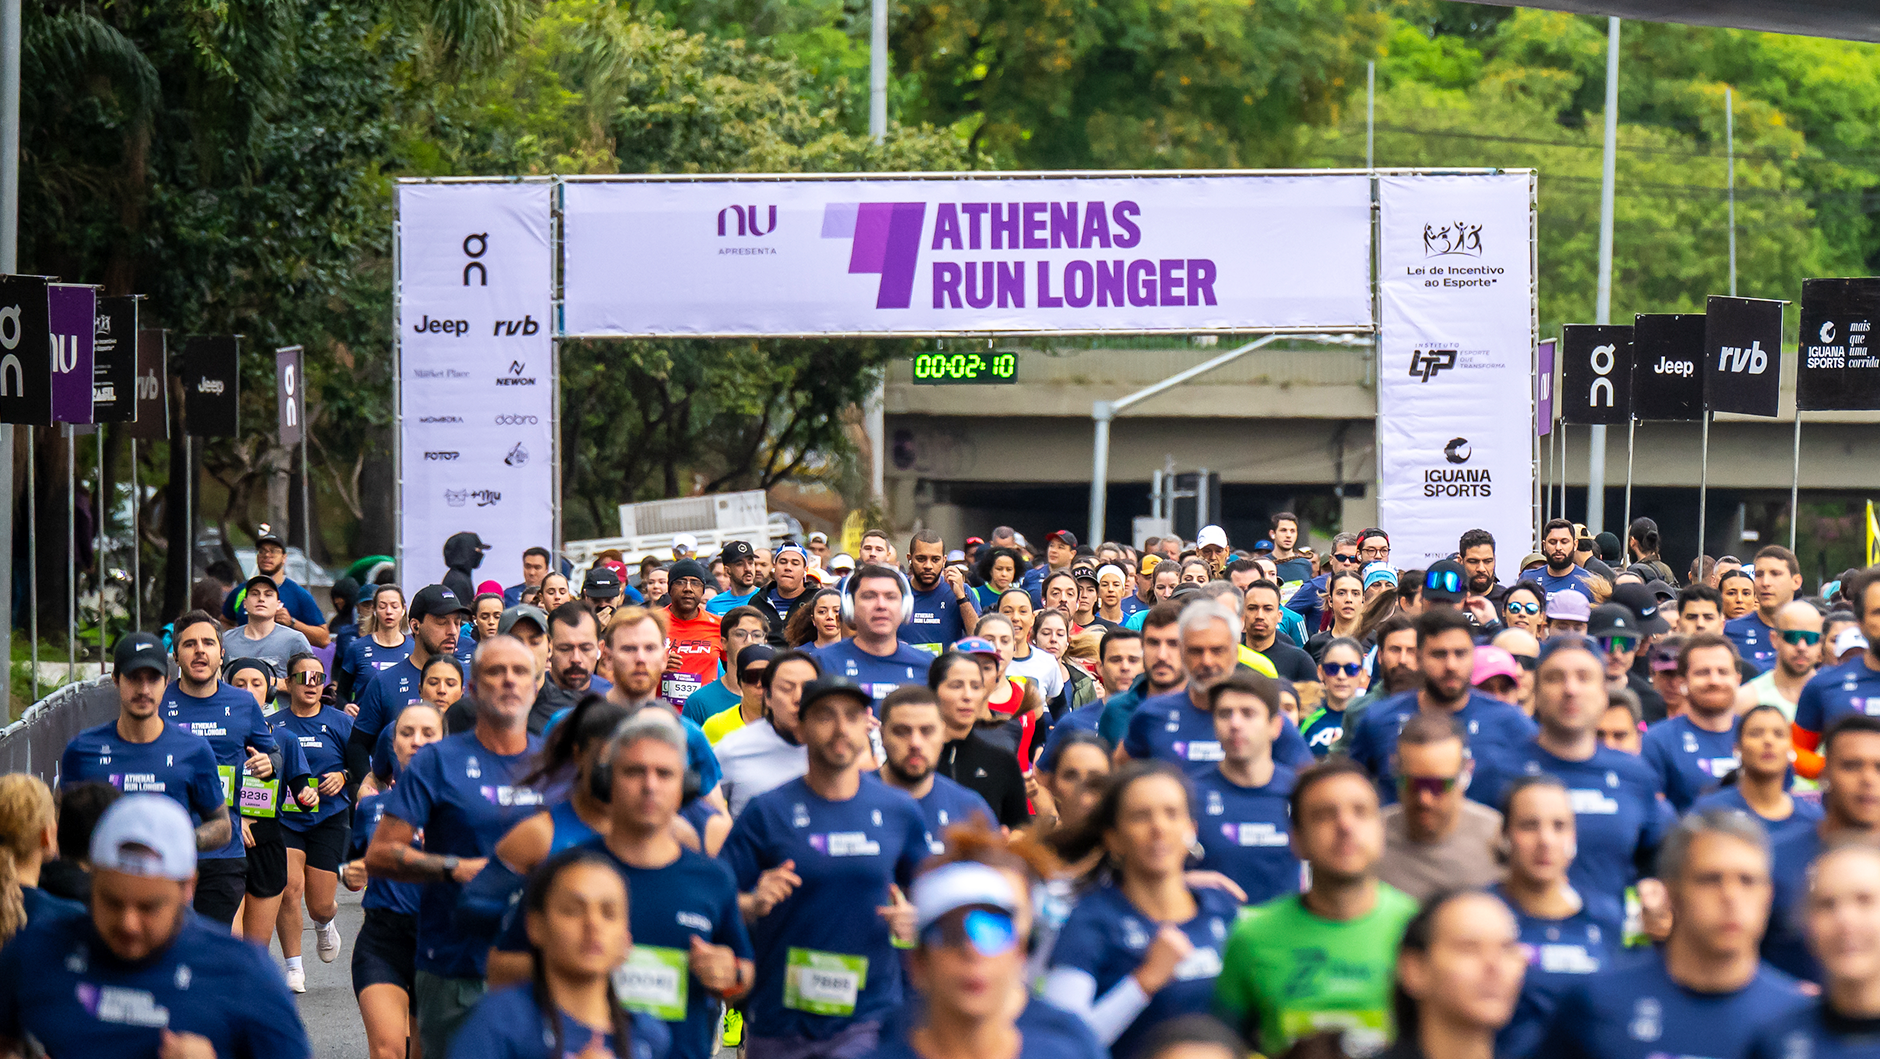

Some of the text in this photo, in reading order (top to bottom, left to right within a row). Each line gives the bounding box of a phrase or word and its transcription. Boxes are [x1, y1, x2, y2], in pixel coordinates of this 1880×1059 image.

[931, 200, 1141, 250] ATHENAS
[717, 247, 778, 256] APRESENTA
[1407, 265, 1505, 275] Lei de Incentivo
[932, 258, 1219, 310] RUN LONGER
[1424, 279, 1439, 287] ao
[414, 315, 469, 337] Jeep
[493, 314, 539, 336] rvb
[1849, 320, 1871, 332] mais
[1849, 334, 1866, 347] que
[1718, 340, 1768, 375] rvb
[1808, 346, 1845, 357] IGUANA
[1848, 347, 1868, 356] uma
[1654, 356, 1695, 378] Jeep
[1807, 357, 1845, 369] SPORTS
[1848, 356, 1880, 368] corrida
[198, 375, 225, 396] Jeep
[1424, 469, 1492, 482] IGUANA
[1424, 484, 1492, 497] SPORTS
[1074, 569, 1093, 577] NYC
[677, 646, 711, 654] RUN
[674, 683, 698, 692] 5337
[240, 790, 268, 801] 8236
